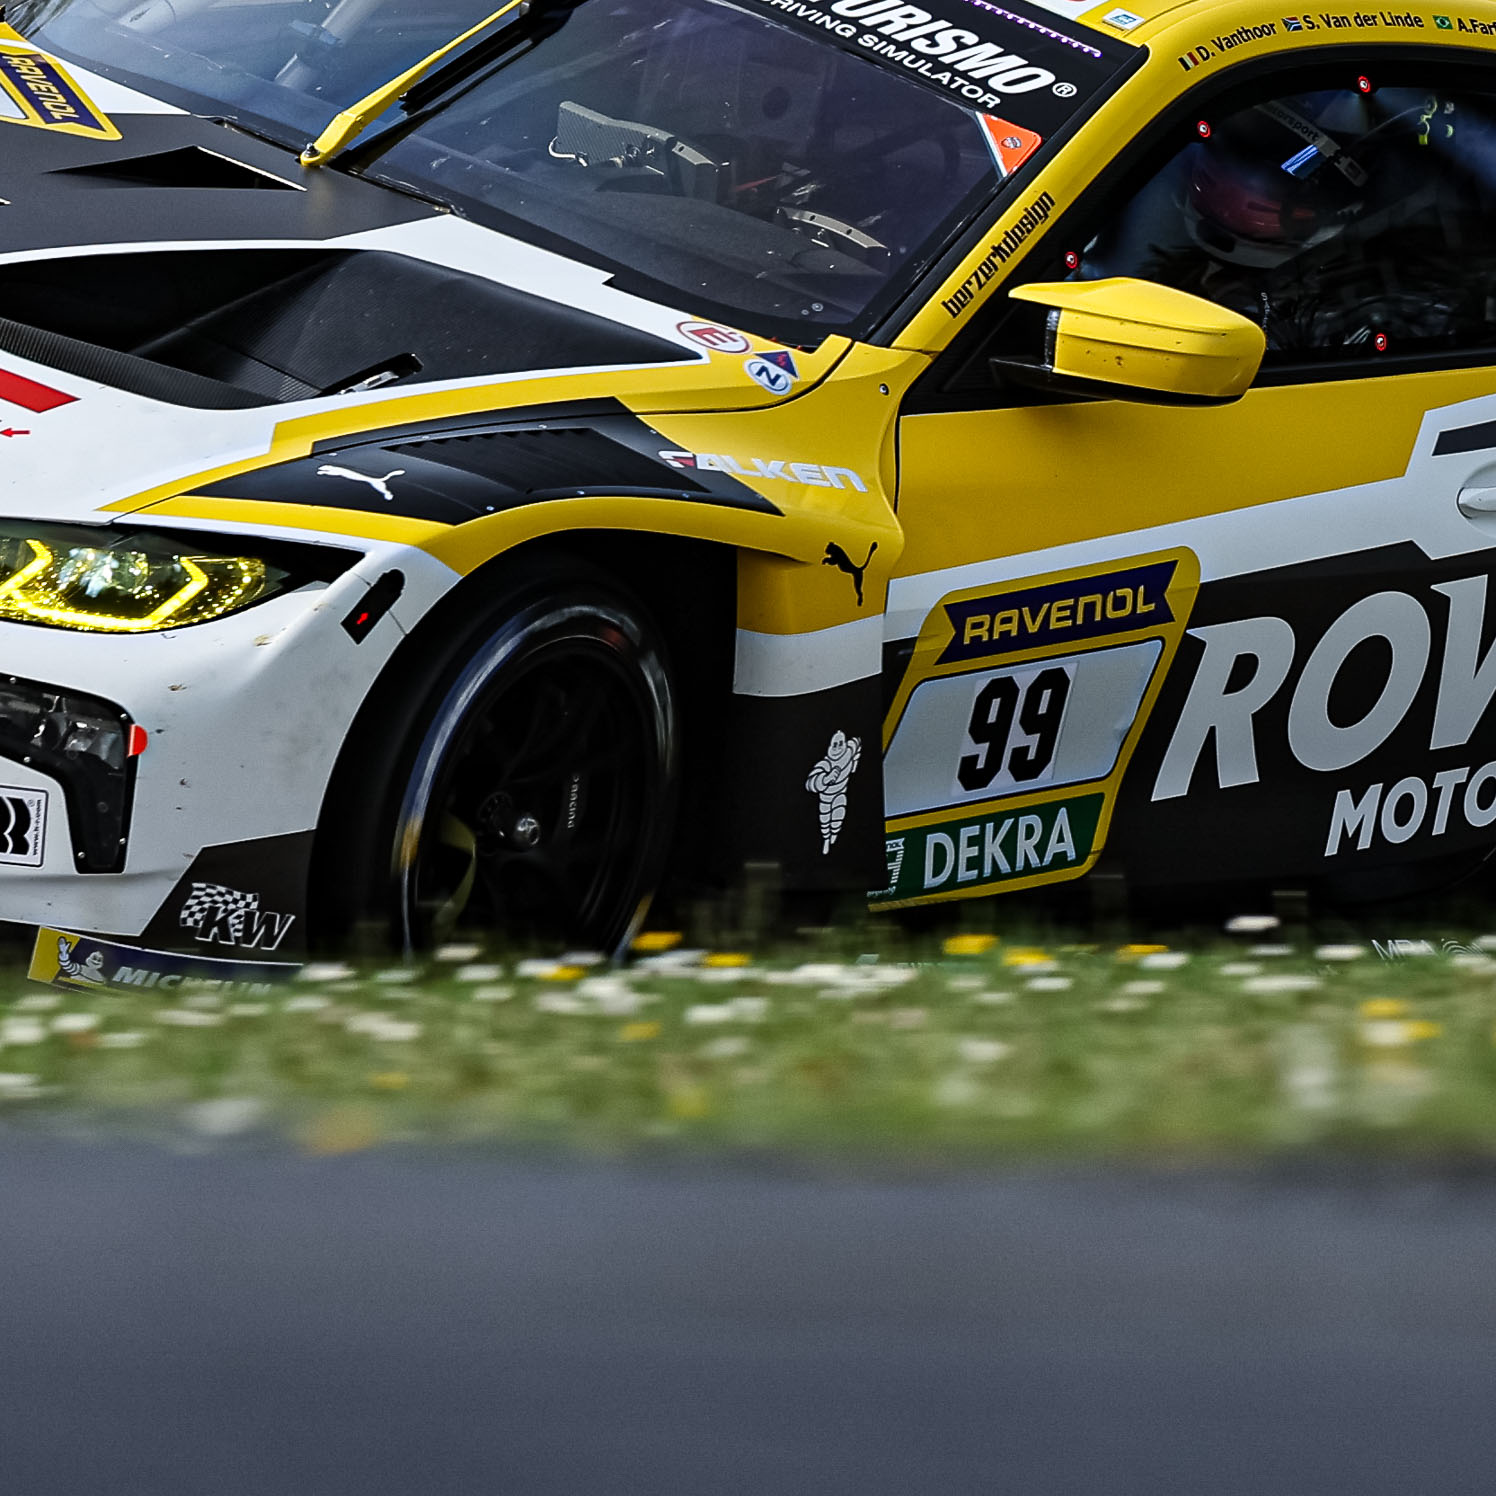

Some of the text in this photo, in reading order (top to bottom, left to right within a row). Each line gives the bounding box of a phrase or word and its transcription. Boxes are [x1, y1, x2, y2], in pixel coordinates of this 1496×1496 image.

[1195, 45, 1216, 63] D.
[1210, 22, 1278, 54] Vanthoor
[1302, 14, 1320, 31] S.
[1319, 12, 1351, 29] Van
[1353, 11, 1378, 28] der
[1379, 11, 1425, 29] Linde
[1, 53, 81, 123] RAVENOL
[857, 32, 1002, 109] SIMULATOR
[658, 450, 869, 493] FALKEN
[962, 584, 1156, 645] RAVENOL
[956, 666, 1071, 792] 99
[922, 806, 1077, 889] DEKRA
[194, 904, 296, 951] KW
